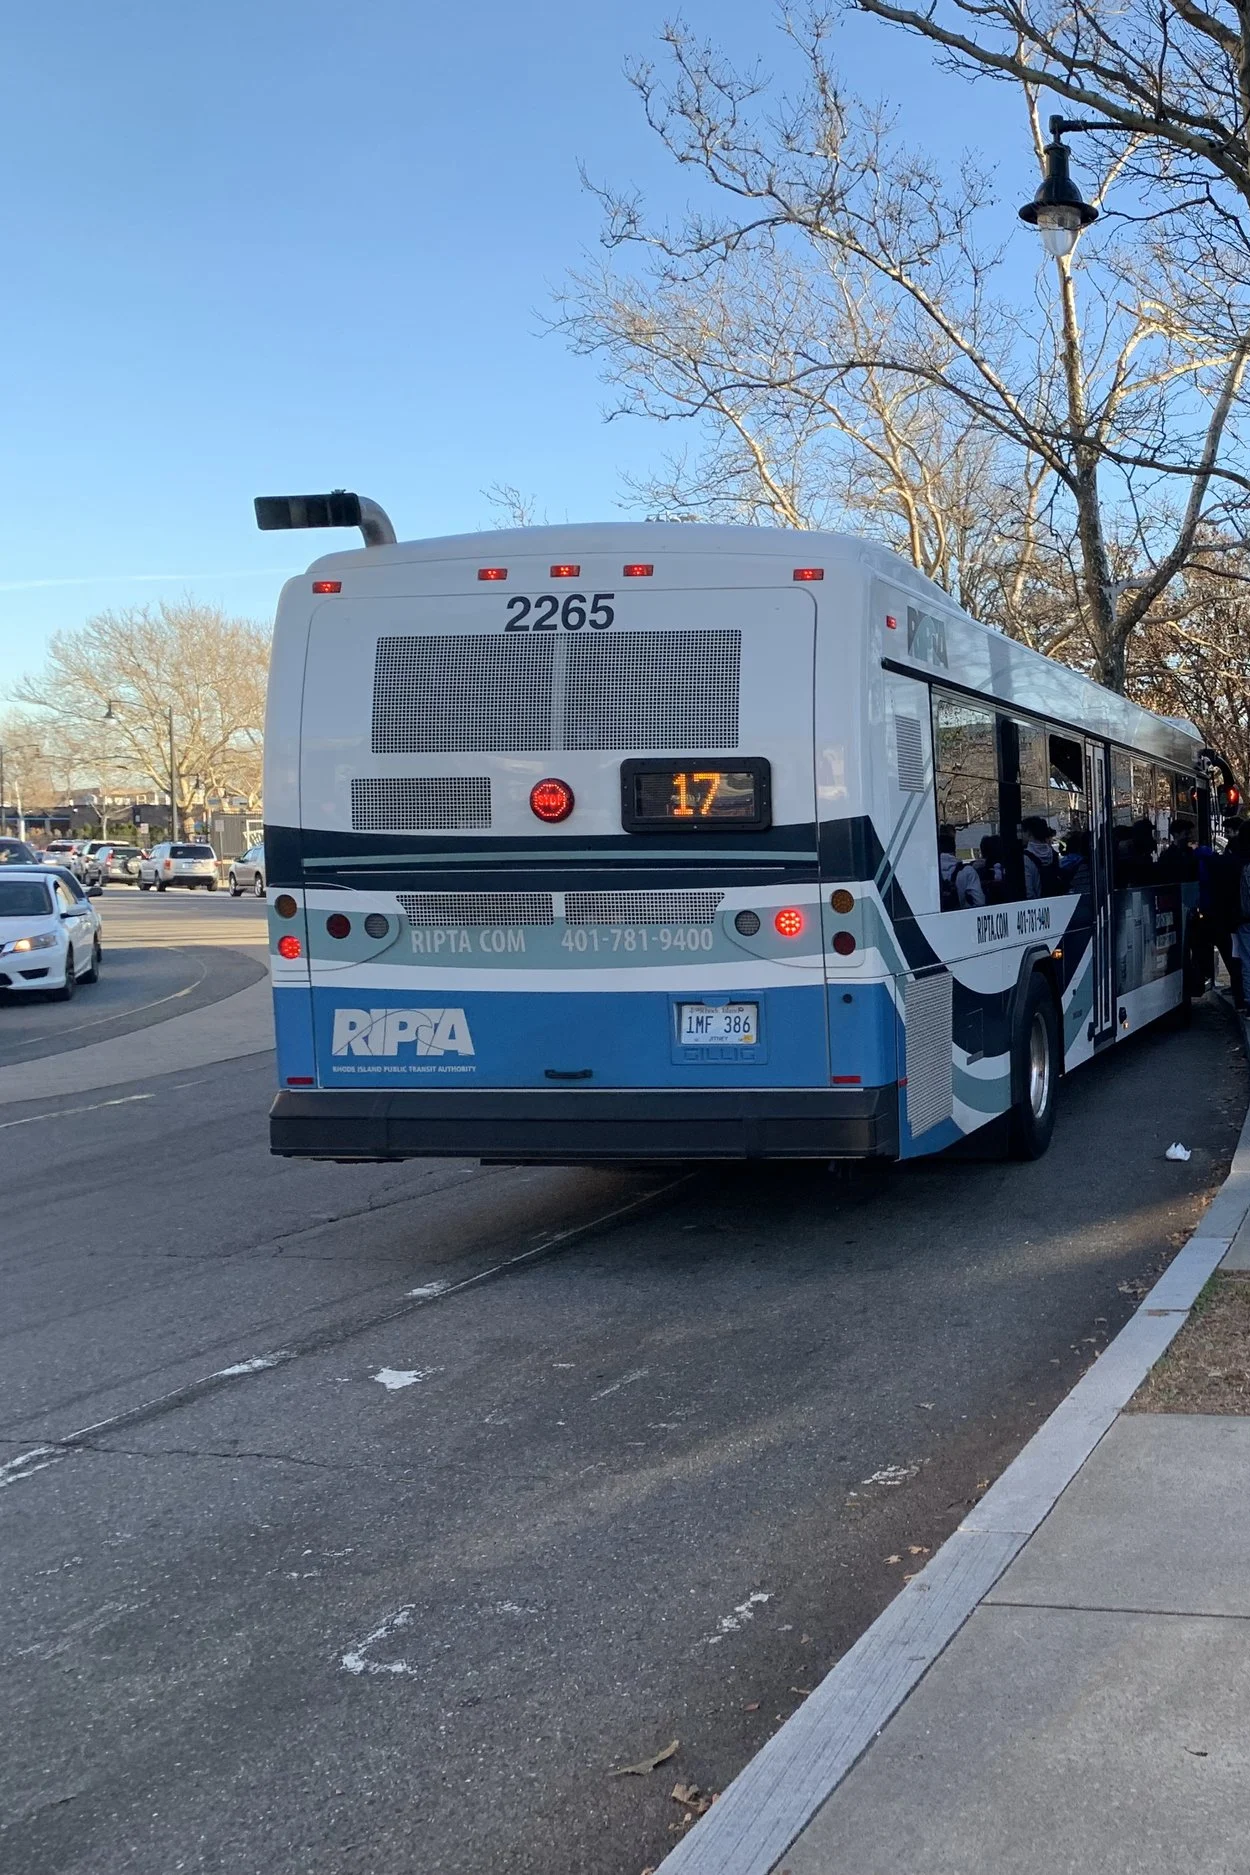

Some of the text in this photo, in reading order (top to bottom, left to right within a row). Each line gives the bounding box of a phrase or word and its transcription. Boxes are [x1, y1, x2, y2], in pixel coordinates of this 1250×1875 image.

[504, 593, 615, 632] 2265
[537, 793, 563, 806] STOP
[673, 772, 720, 815] 17
[411, 928, 714, 953] RIPTA COM 401-781-9400
[977, 906, 1051, 944] RIPTA.COM 401-781-9400
[332, 1008, 476, 1056] RIPTA
[686, 1015, 751, 1034] 1MF 386
[332, 1065, 476, 1073] RHODE ISLAND PUBLIC TRANSIT AUTHORITY
